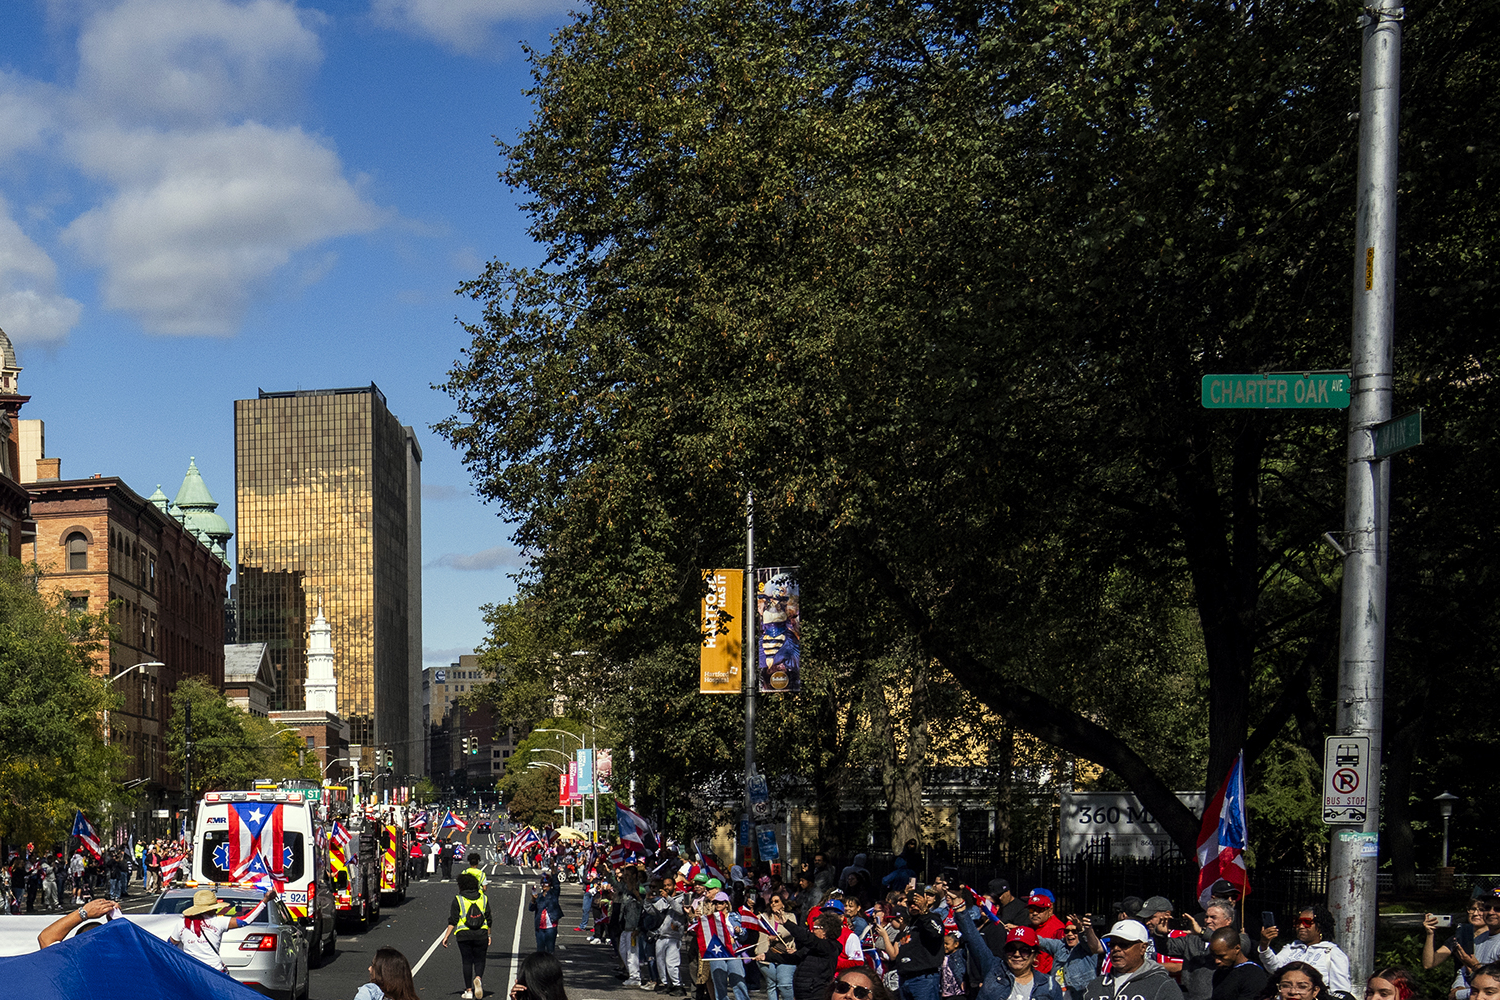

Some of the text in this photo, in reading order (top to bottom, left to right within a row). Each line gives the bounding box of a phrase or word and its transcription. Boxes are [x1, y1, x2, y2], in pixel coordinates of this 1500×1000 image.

[1209, 379, 1343, 404] CHARTER OAK AVE
[1382, 421, 1406, 450] MAIN
[717, 574, 726, 608] HAS IT
[307, 790, 320, 798] ST
[1326, 797, 1365, 805] BUS STOP
[1079, 807, 1120, 824] 360
[290, 893, 306, 902] 924
[1015, 927, 1028, 938] NY
